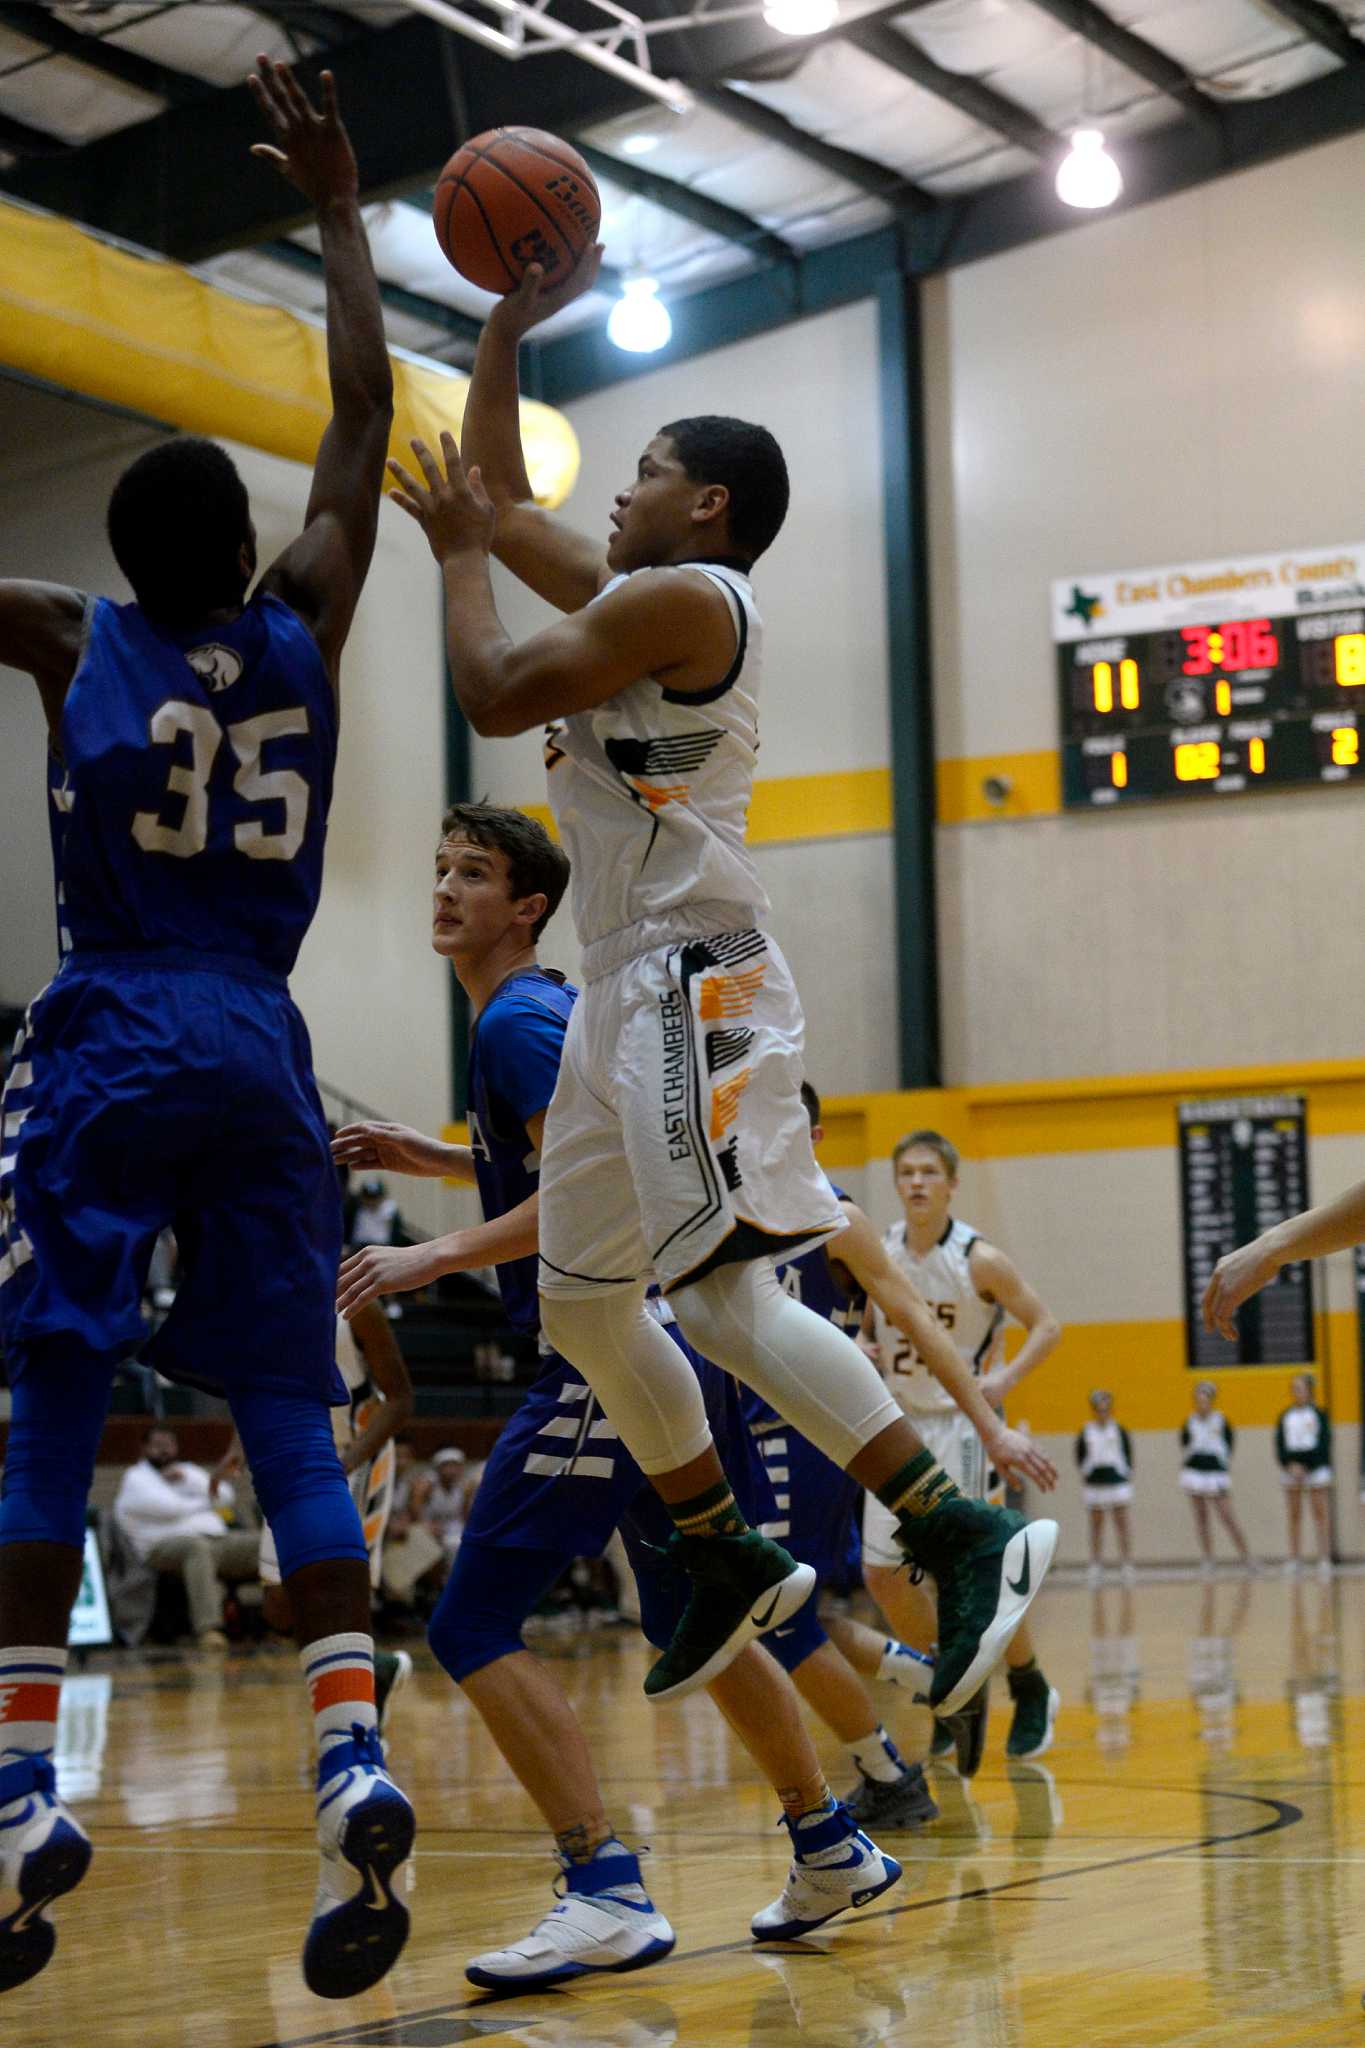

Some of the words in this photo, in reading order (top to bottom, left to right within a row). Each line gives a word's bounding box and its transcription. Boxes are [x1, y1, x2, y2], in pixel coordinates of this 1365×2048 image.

[1180, 618, 1279, 676] 3:06
[1334, 633, 1365, 687] 8
[1092, 658, 1140, 713] 11
[1331, 727, 1359, 766] 2
[131, 700, 310, 861] 35
[659, 988, 685, 1105] CHAMBERS
[664, 1106, 691, 1162] EAST
